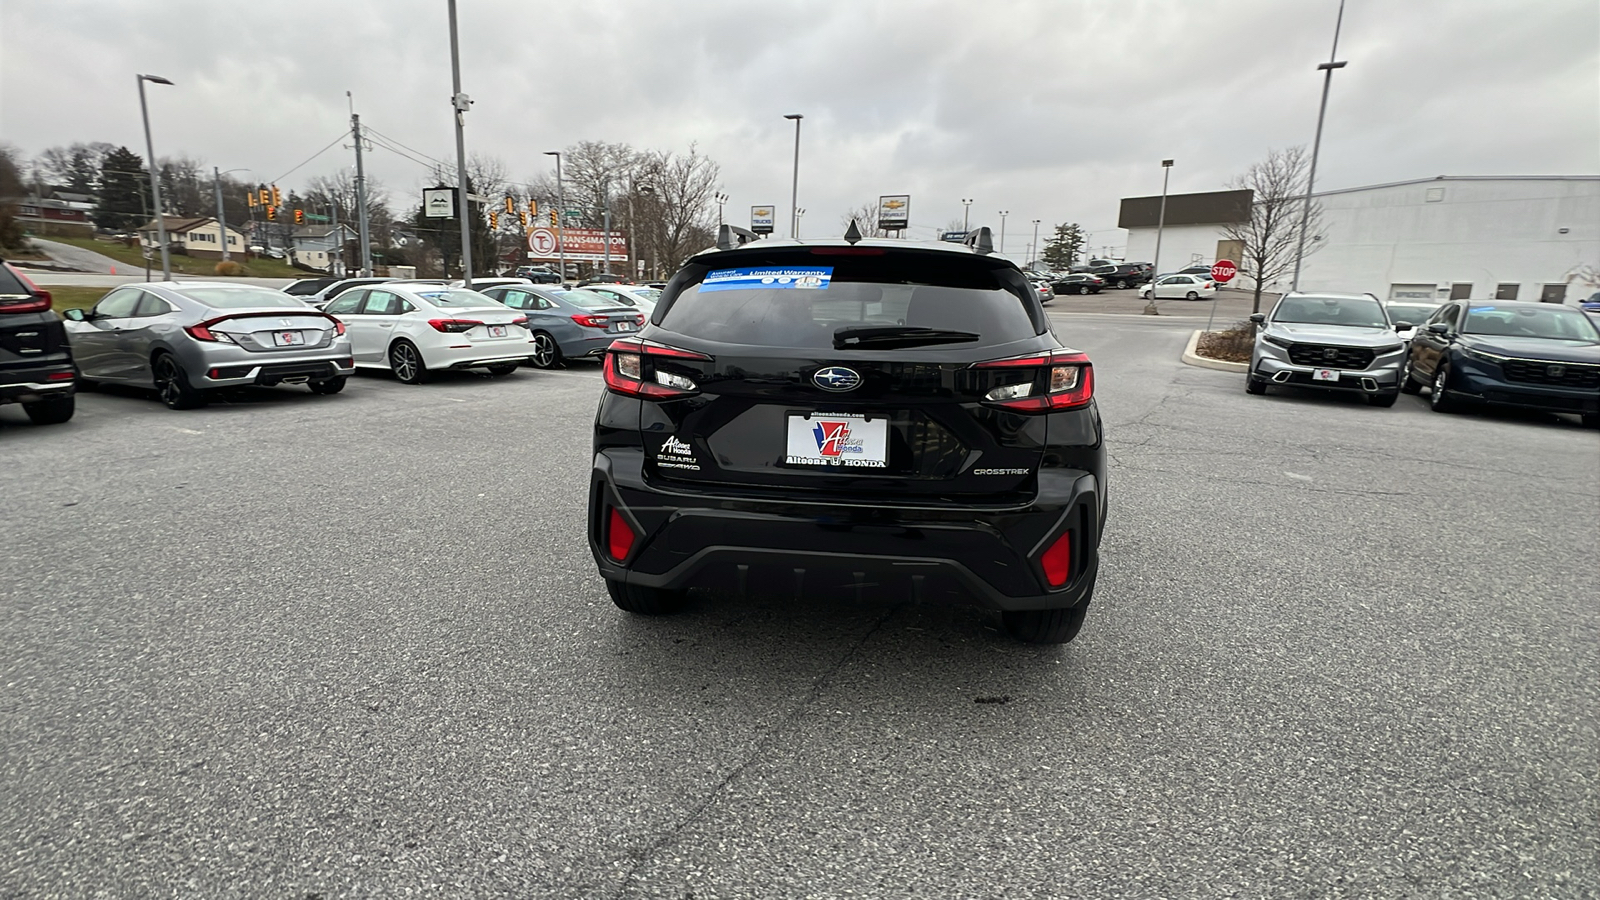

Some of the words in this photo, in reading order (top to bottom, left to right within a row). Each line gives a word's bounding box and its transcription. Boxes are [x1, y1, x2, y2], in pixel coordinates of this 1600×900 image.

[1211, 266, 1236, 277] STOP
[837, 444, 863, 453] Honda
[657, 454, 697, 463] SUBARU
[785, 456, 828, 466] Altoona
[844, 459, 887, 468] HONDA
